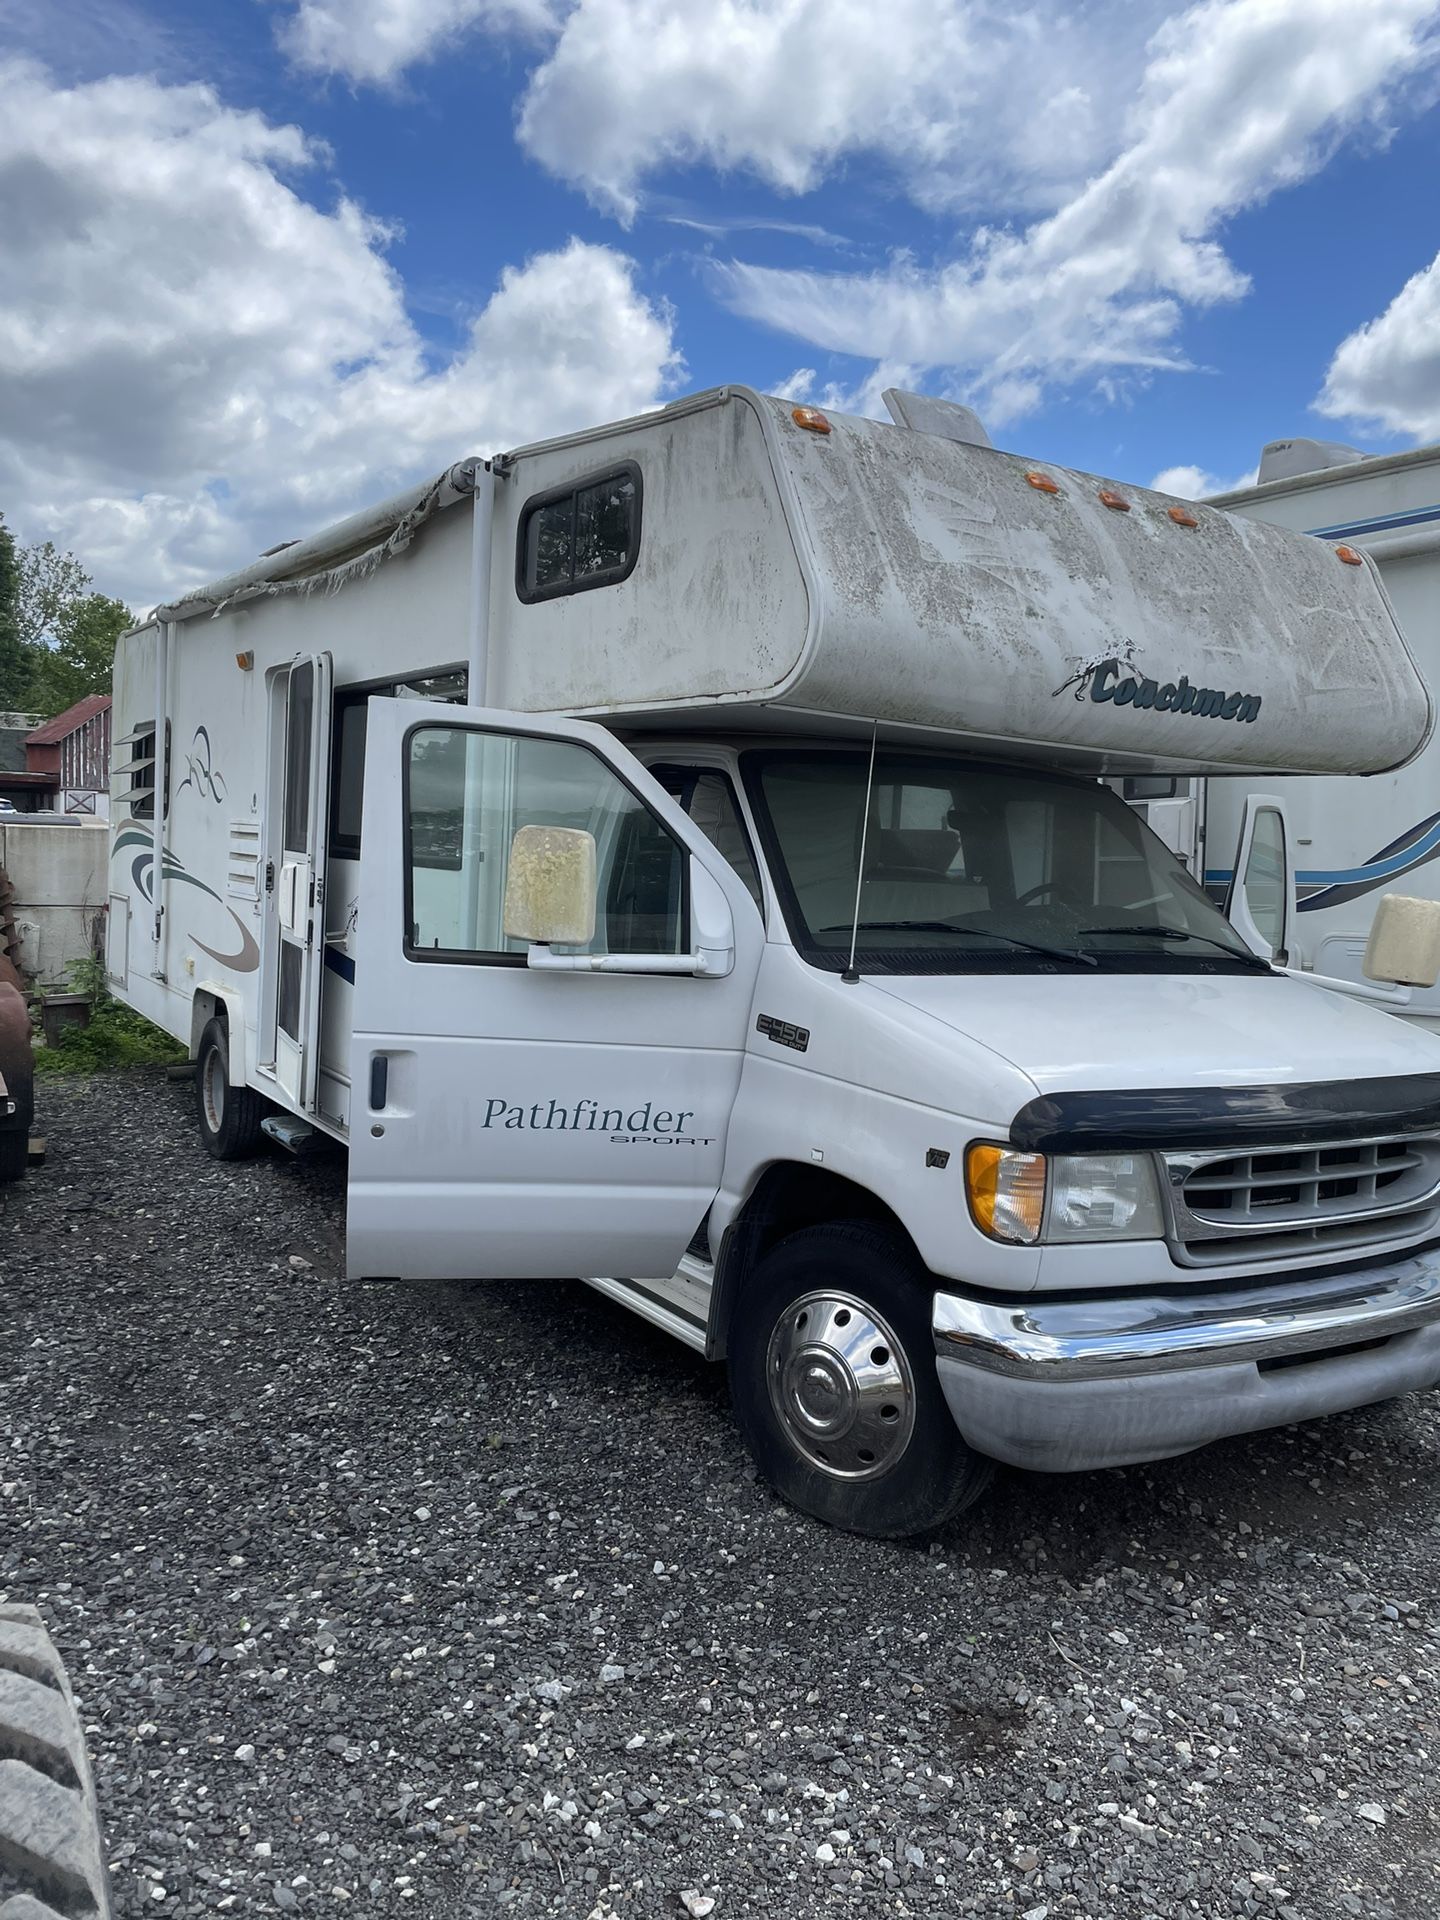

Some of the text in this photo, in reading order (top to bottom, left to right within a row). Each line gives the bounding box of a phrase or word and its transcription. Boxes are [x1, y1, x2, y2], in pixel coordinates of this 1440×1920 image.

[1091, 658, 1262, 723] Coachmen
[770, 1034, 806, 1051] SUPER DUTY
[480, 1099, 694, 1134] Pathfinder
[610, 1135, 717, 1146] SPORT
